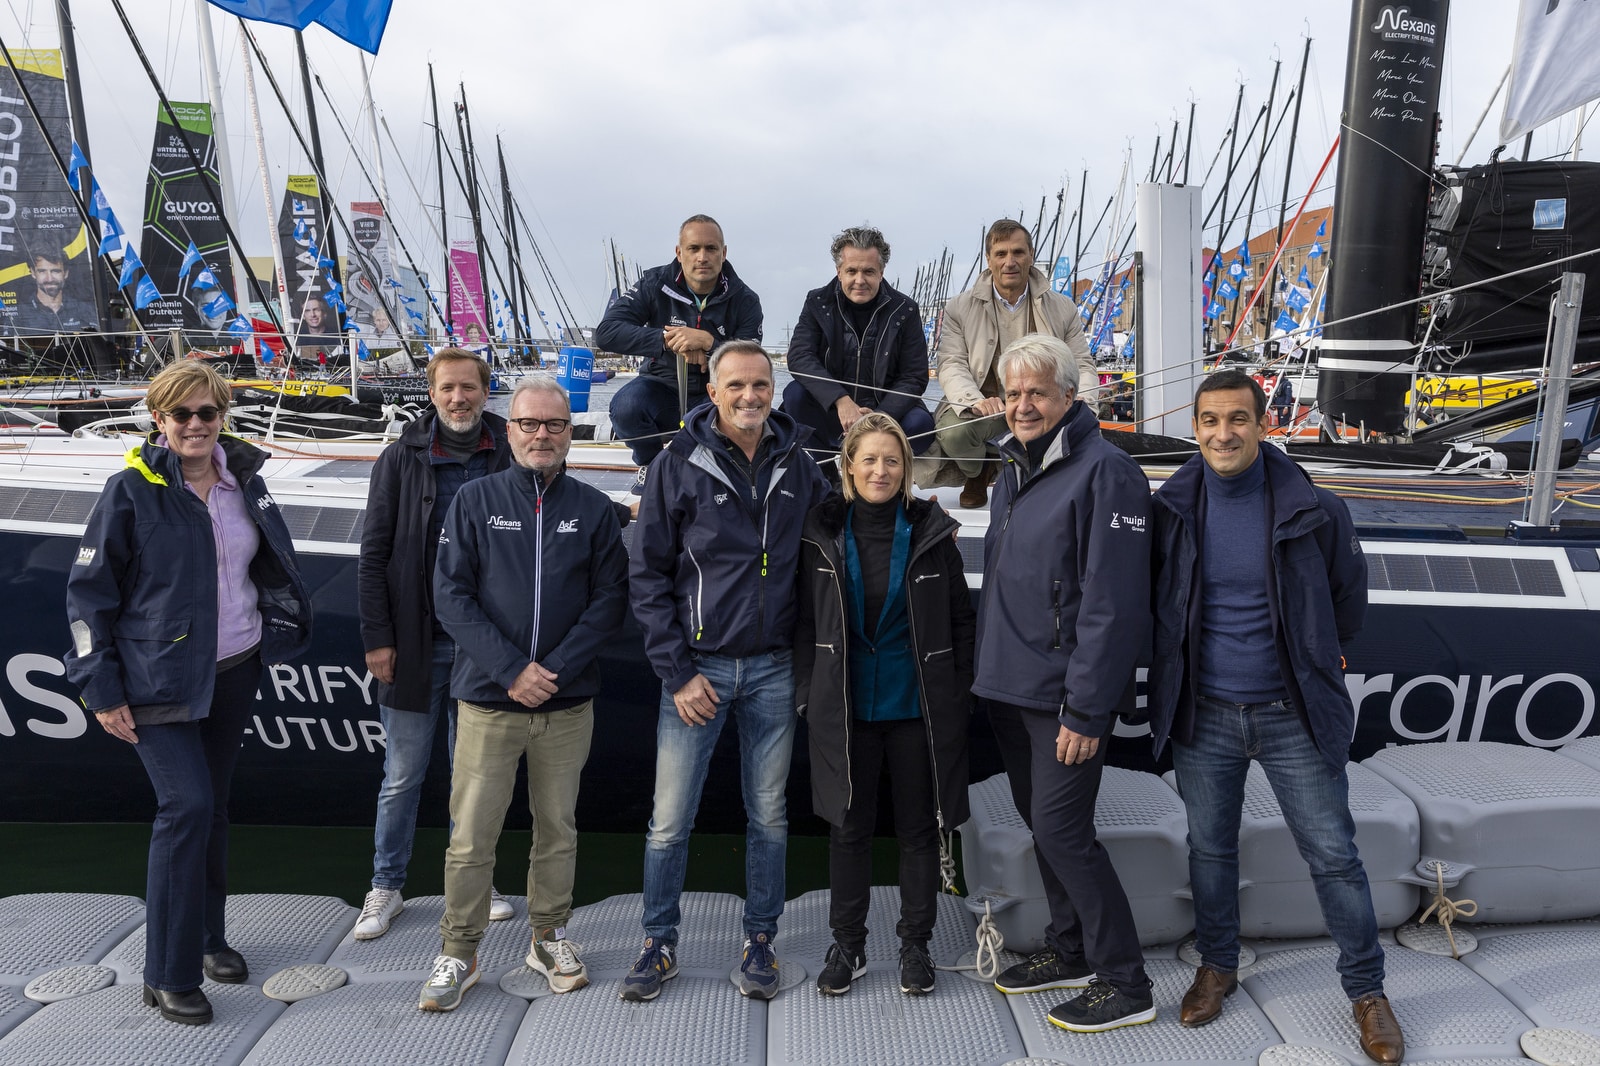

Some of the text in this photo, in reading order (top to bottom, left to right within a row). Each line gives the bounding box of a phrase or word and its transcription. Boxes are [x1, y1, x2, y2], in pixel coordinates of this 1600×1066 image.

[1374, 8, 1436, 35] Nexans
[1385, 31, 1411, 39] ELECTRIFY
[1420, 36, 1435, 44] FUTURE
[146, 300, 182, 309] enjamin
[149, 308, 183, 316] Dutreux
[487, 515, 522, 527] Nexans
